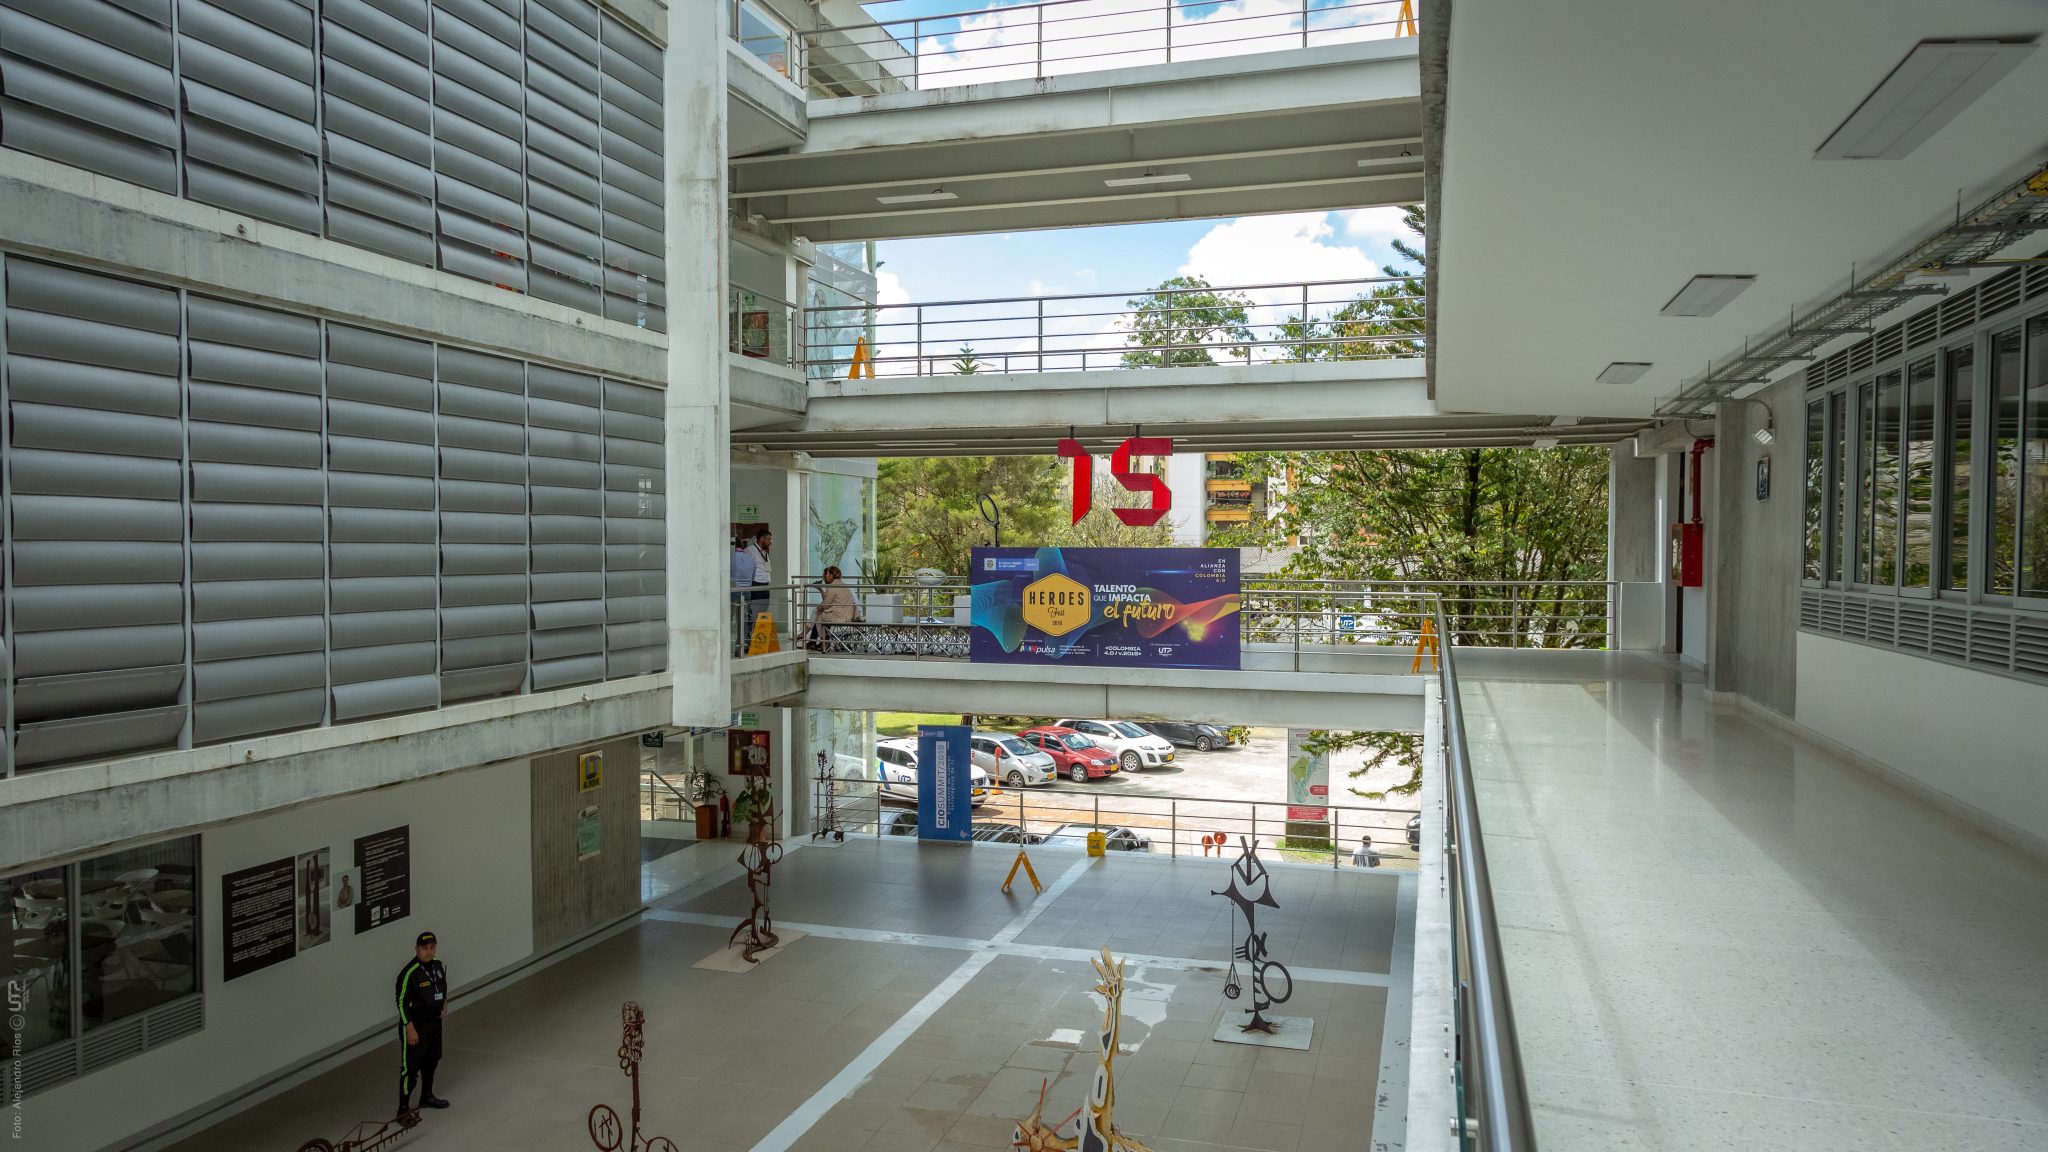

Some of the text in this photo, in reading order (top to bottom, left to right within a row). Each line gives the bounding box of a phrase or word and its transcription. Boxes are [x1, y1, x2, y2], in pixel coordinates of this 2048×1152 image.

[1094, 584, 1137, 593] TALENTO
[1029, 591, 1084, 606] HEROES
[1093, 593, 1152, 602] QUE IMPACTA
[1047, 606, 1065, 618] Fest
[1104, 597, 1175, 628] el futuro
